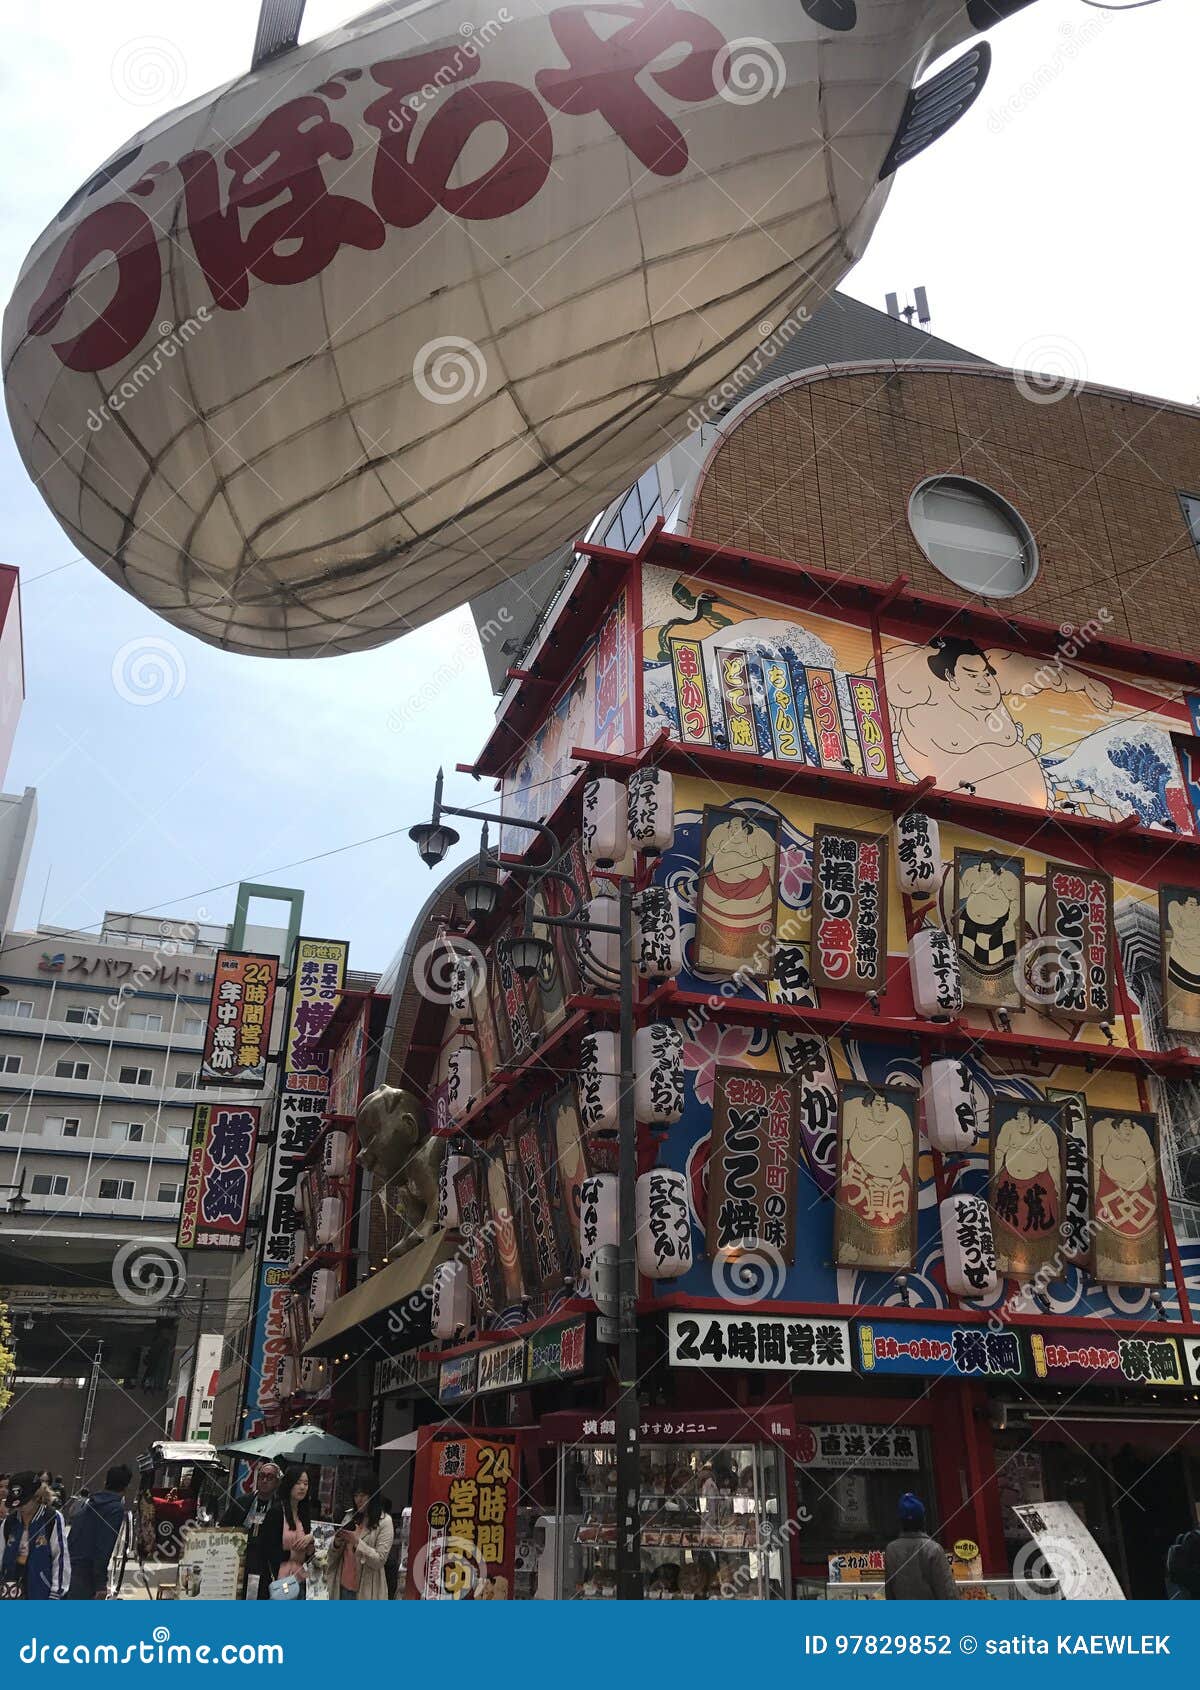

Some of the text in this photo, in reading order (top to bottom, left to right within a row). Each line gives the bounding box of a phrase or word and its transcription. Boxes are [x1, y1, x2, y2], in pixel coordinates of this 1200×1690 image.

[677, 645, 706, 739] 串かつ
[723, 656, 753, 747] どて焼
[768, 665, 798, 756] ちゃんこ
[812, 677, 843, 762] もつ鍋
[854, 683, 886, 772] 串かつ
[67, 954, 191, 986] スパワールド
[300, 961, 320, 998] 串かつ
[302, 945, 342, 960] 新世界
[319, 962, 338, 999] 日本一の
[1087, 880, 1108, 1011] 大阪下町の味
[211, 981, 242, 1069] 年中無休
[237, 963, 271, 1067] 24時間営業
[291, 1000, 335, 1073] 横綱
[180, 1148, 204, 1245] 日本一の串かつ
[202, 1112, 254, 1225] 横綱
[717, 1106, 769, 1250] どて焼
[764, 1084, 791, 1248] 大阪下町の味
[676, 1320, 845, 1366] 24時間営業
[874, 1337, 952, 1361] 日本一の串かつ
[952, 1330, 1022, 1375] 横綱
[1045, 1345, 1119, 1369] 日本一の串かつ
[1118, 1339, 1180, 1381] 横綱
[583, 1419, 718, 1436] 横綱 すすめメニュー
[476, 1446, 513, 1564] 24時間
[837, 1551, 885, 1569] これが横
